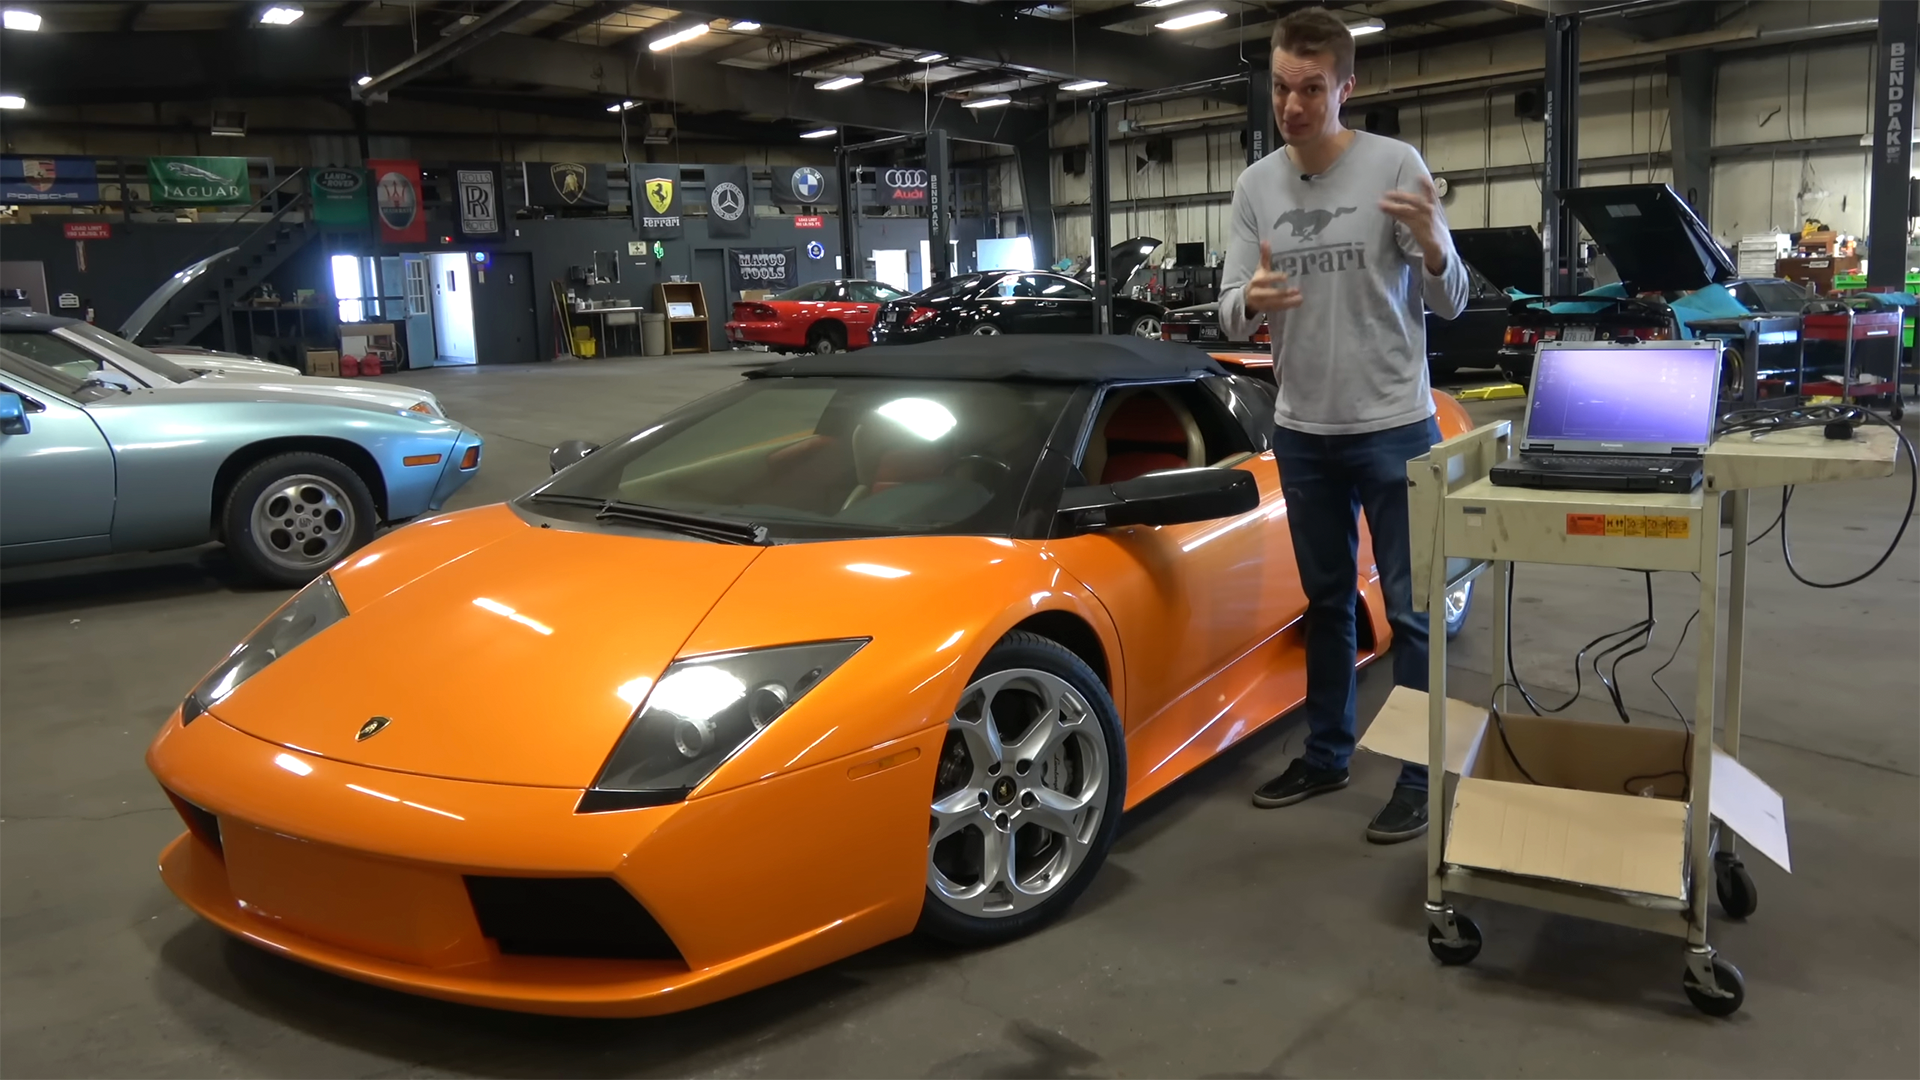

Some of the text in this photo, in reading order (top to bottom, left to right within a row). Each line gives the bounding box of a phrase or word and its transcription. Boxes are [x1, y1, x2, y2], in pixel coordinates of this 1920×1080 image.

[1886, 43, 1905, 145] BENDPAK
[1253, 131, 1262, 162] BEN
[461, 173, 490, 182] ROLLS
[794, 168, 821, 179] BMW
[7, 192, 79, 200] PORSCHE
[164, 185, 239, 197] JAGUAR
[892, 189, 925, 199] Audi
[465, 221, 495, 230] ROYCE
[643, 216, 680, 228] Ferrari
[738, 253, 786, 267] MATCO
[740, 267, 786, 280] TOOLS
